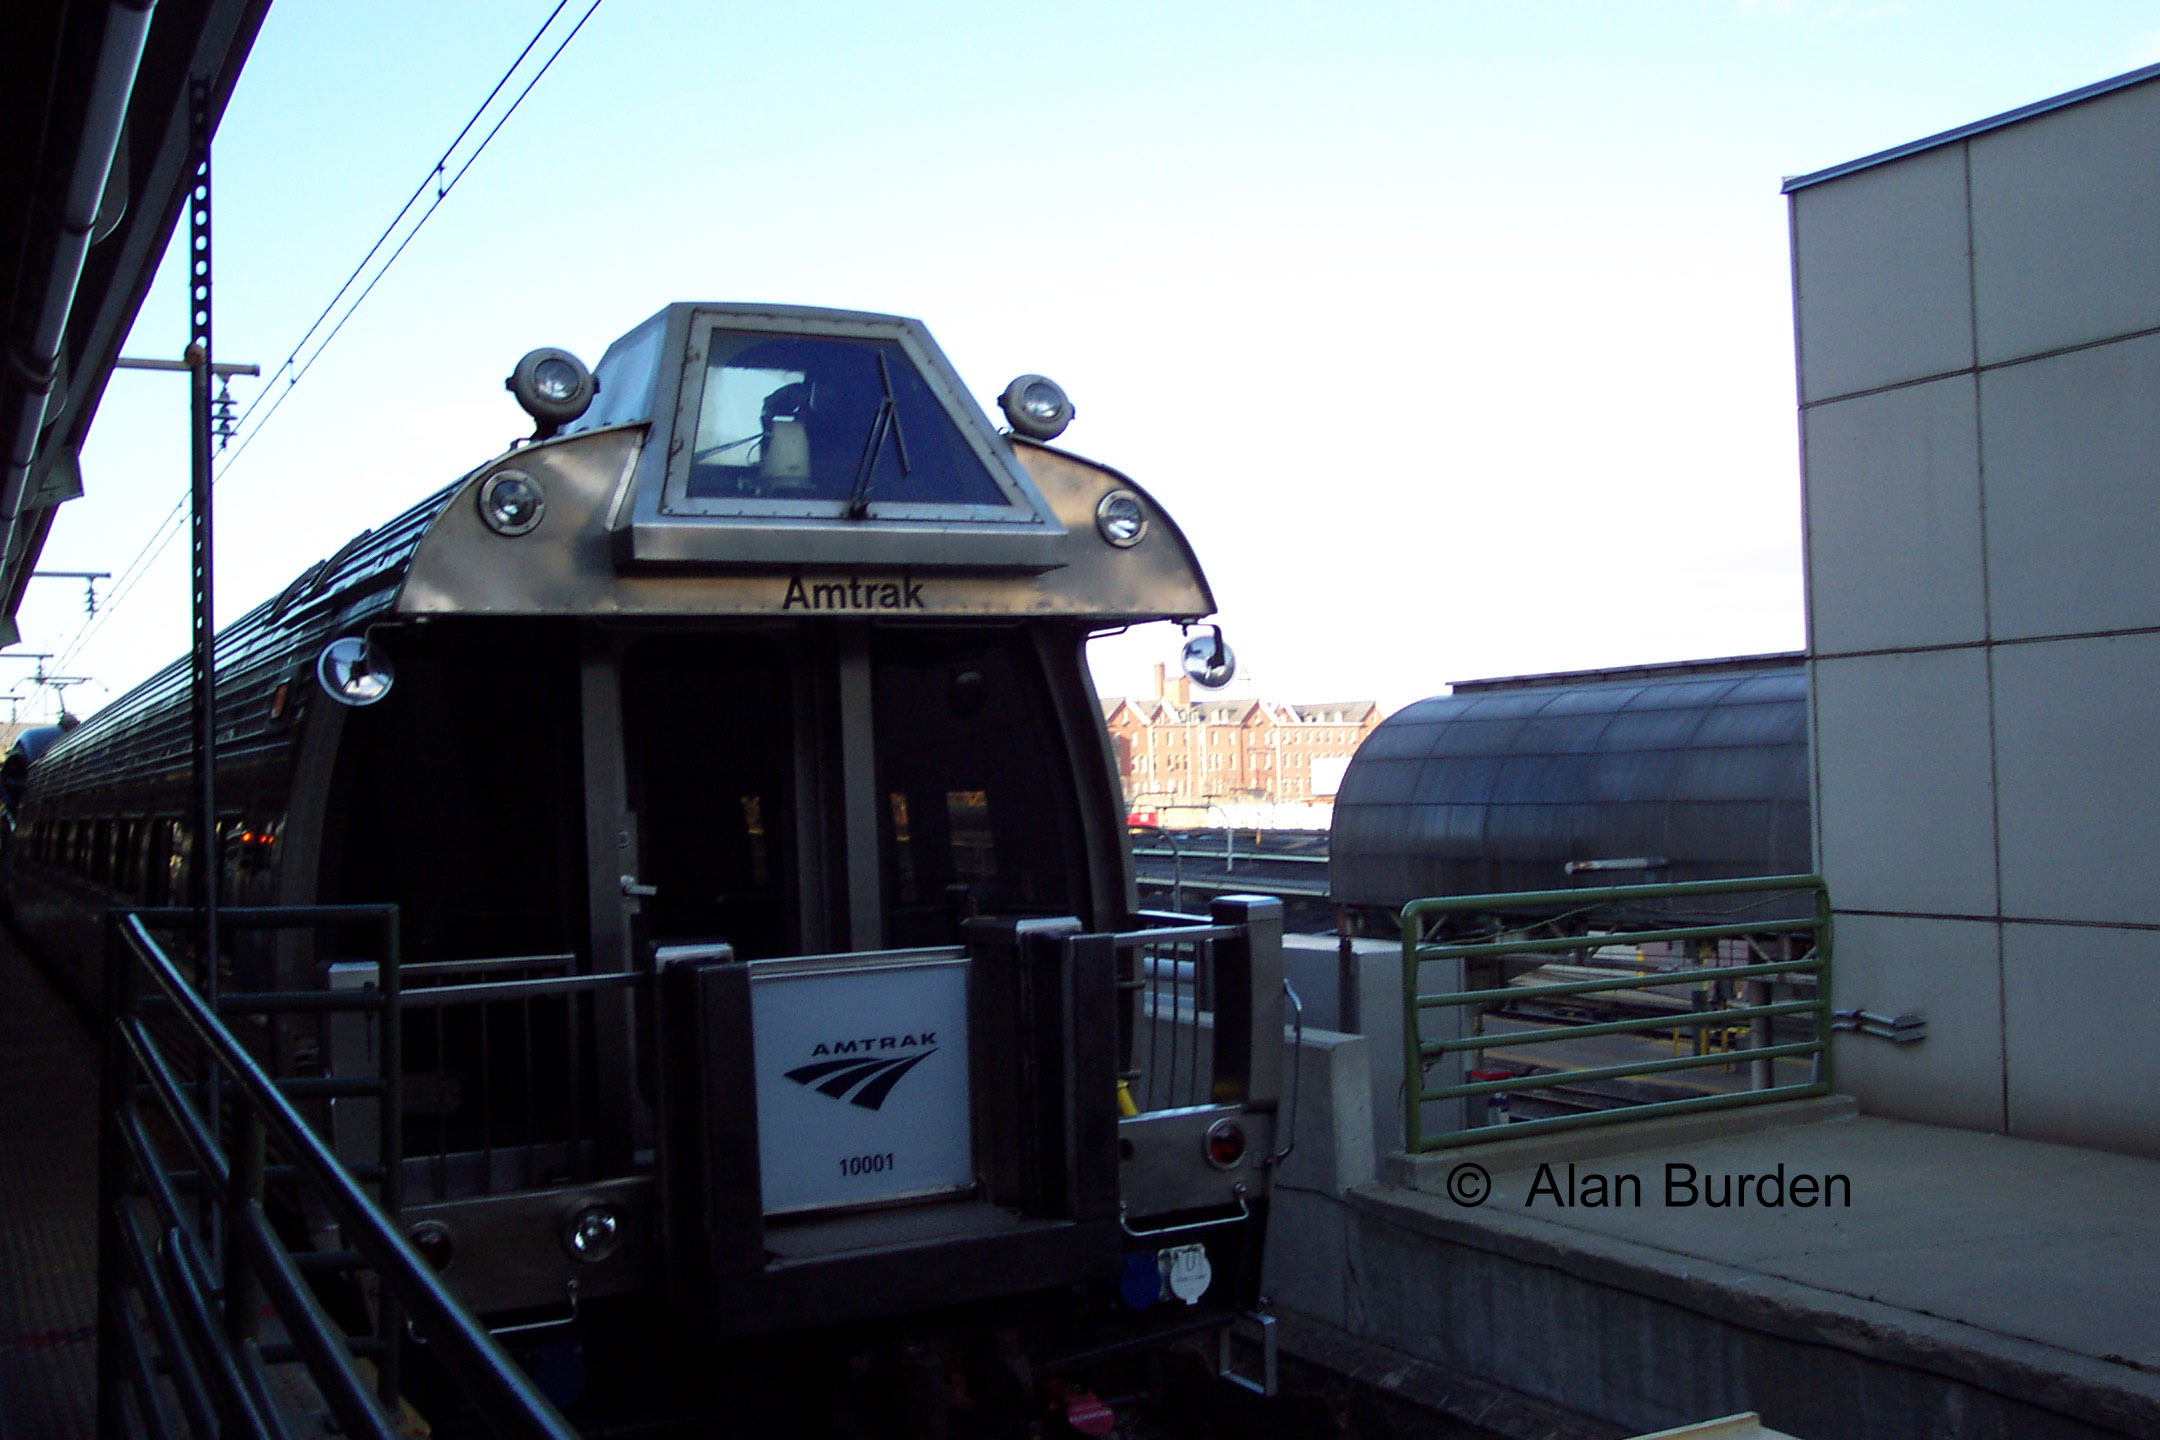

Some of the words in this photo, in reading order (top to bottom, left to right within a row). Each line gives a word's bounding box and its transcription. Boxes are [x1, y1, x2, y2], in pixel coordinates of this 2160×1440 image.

[783, 575, 924, 609] Amtrak
[811, 1032, 937, 1056] AMTRAK
[839, 1153, 894, 1177] 10001
